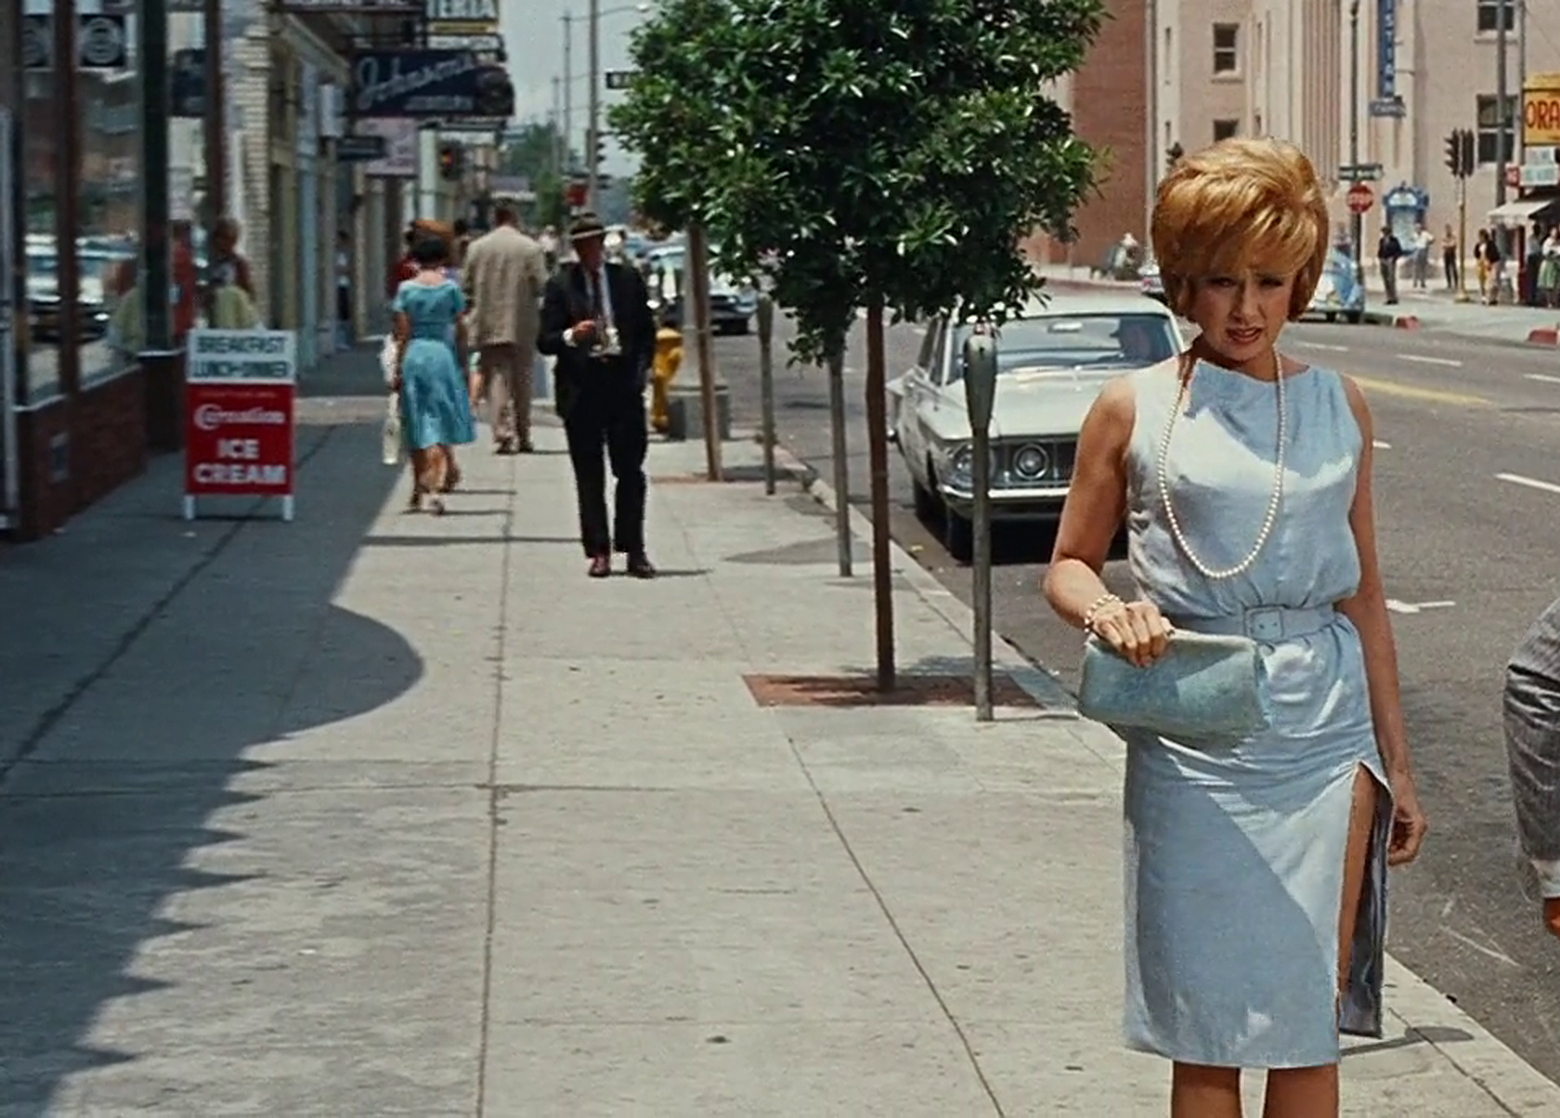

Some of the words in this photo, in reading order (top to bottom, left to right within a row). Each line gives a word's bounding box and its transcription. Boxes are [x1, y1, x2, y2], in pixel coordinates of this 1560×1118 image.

[196, 336, 286, 353] BREAKFAST
[218, 438, 260, 459] ICE
[193, 463, 287, 484] CREAM
